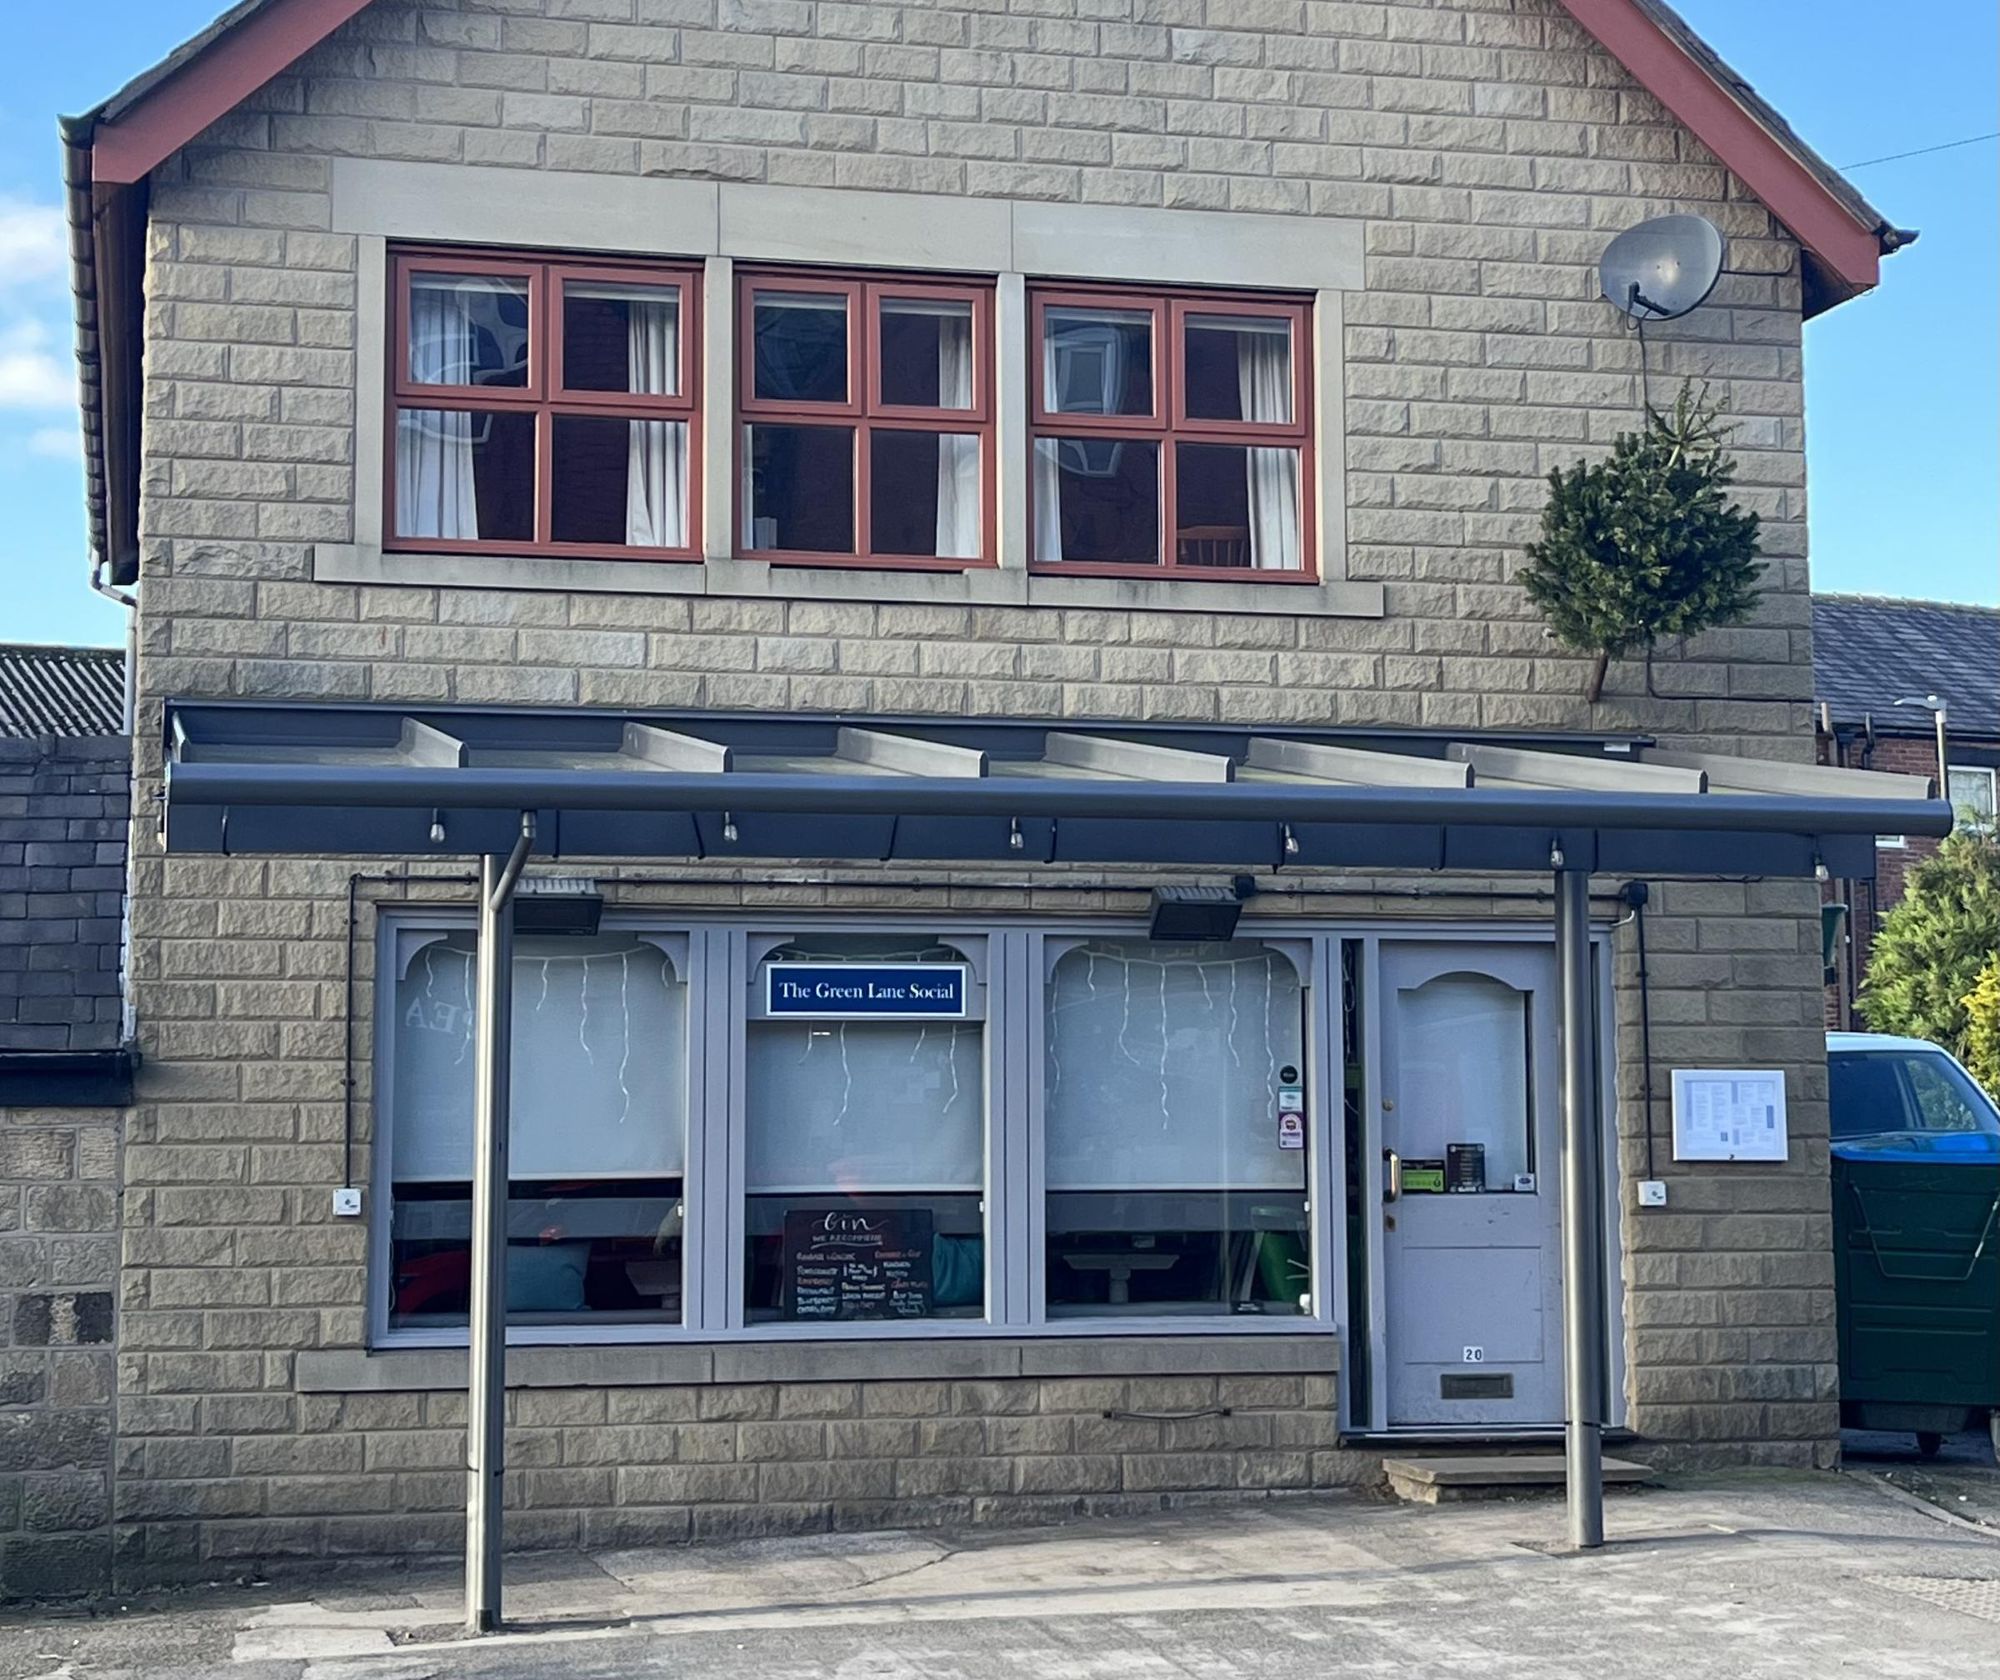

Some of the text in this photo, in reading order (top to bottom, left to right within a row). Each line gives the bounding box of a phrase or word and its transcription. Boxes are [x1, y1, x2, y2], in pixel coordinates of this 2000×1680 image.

[779, 982, 954, 999] The Green Lane Social
[811, 1211, 890, 1231] Gin
[1466, 1349, 1482, 1360] 20
